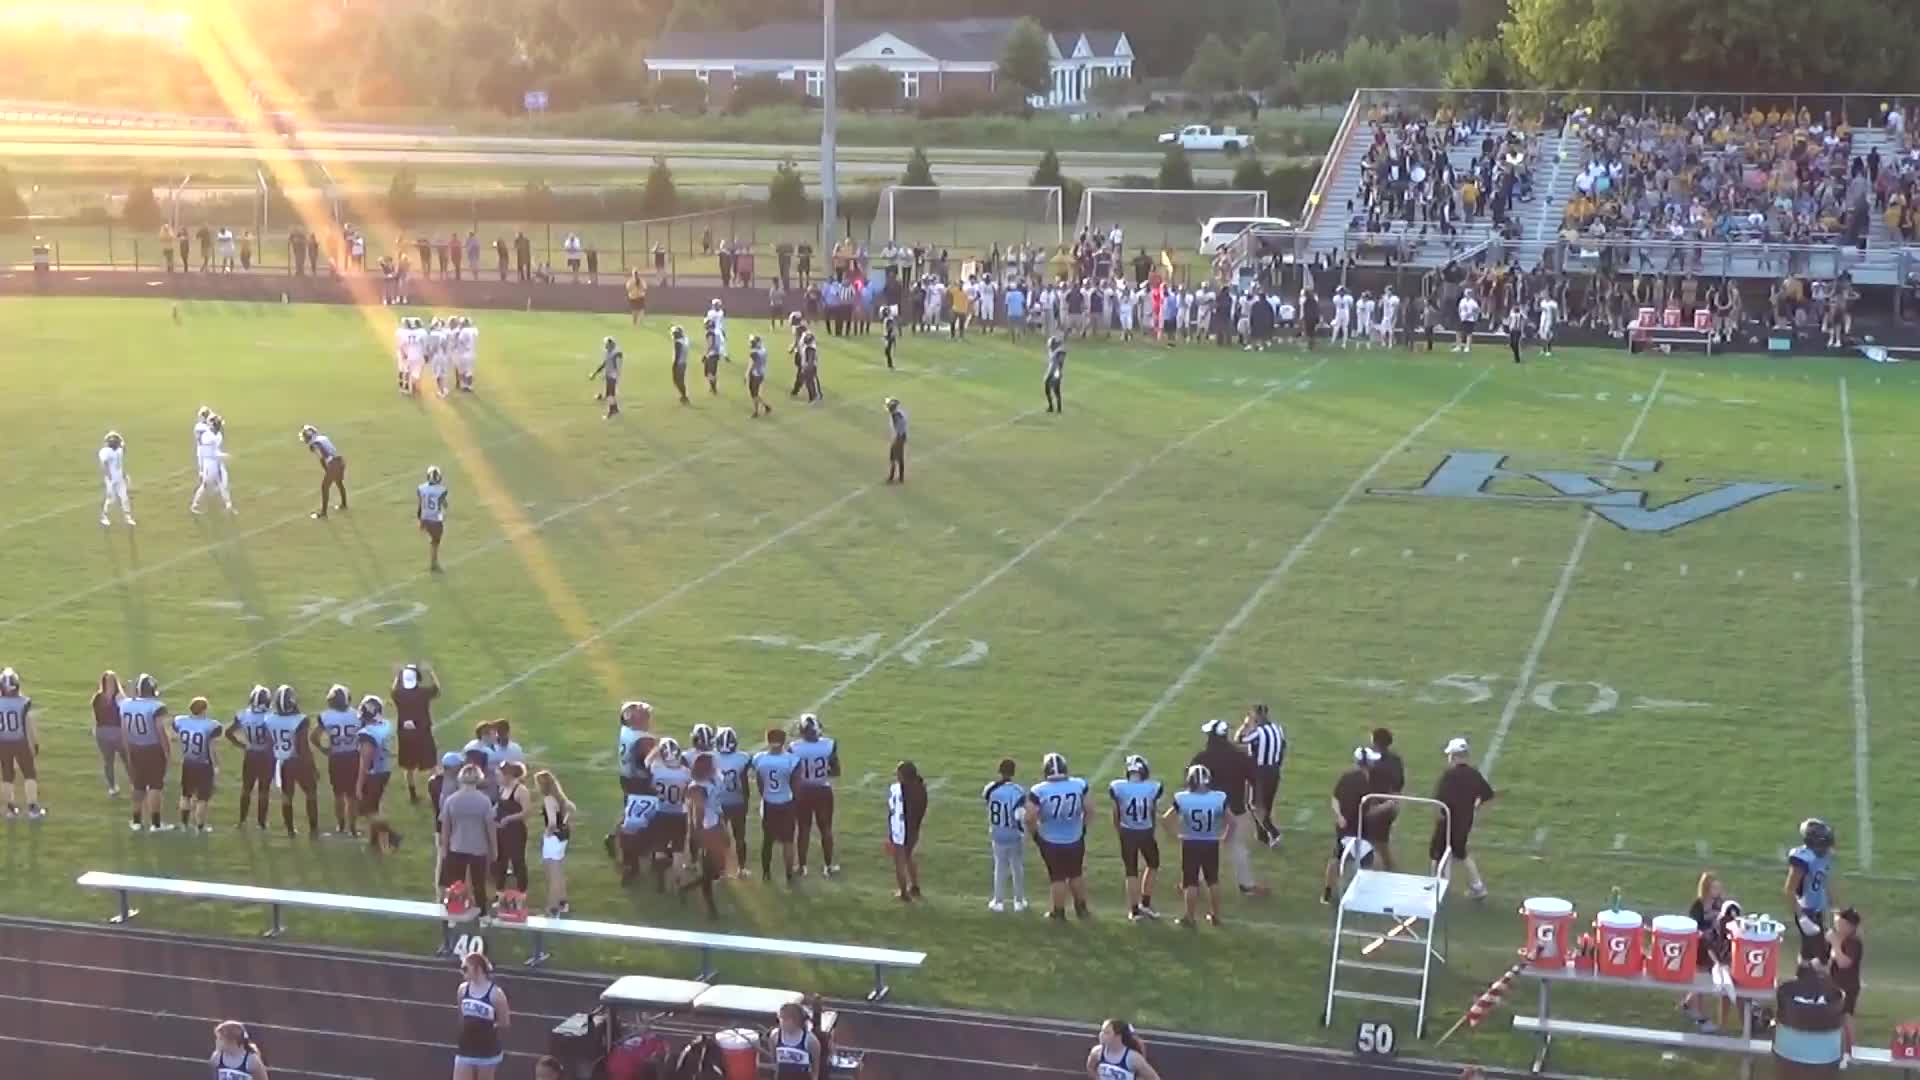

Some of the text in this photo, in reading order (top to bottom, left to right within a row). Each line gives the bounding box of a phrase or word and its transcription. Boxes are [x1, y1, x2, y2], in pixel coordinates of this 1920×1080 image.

[123, 712, 147, 735] 70
[180, 730, 204, 756] 99
[804, 756, 826, 779] 12
[769, 769, 779, 790] 5
[990, 800, 1010, 827] 81
[1050, 792, 1077, 819] 77
[1126, 797, 1148, 821] 41
[1191, 809, 1212, 833] 51
[1537, 924, 1554, 941] G
[1610, 937, 1625, 951] G
[453, 934, 484, 960] 40
[1665, 943, 1681, 957] G
[1748, 950, 1763, 964] G
[1358, 1023, 1393, 1054] 50
